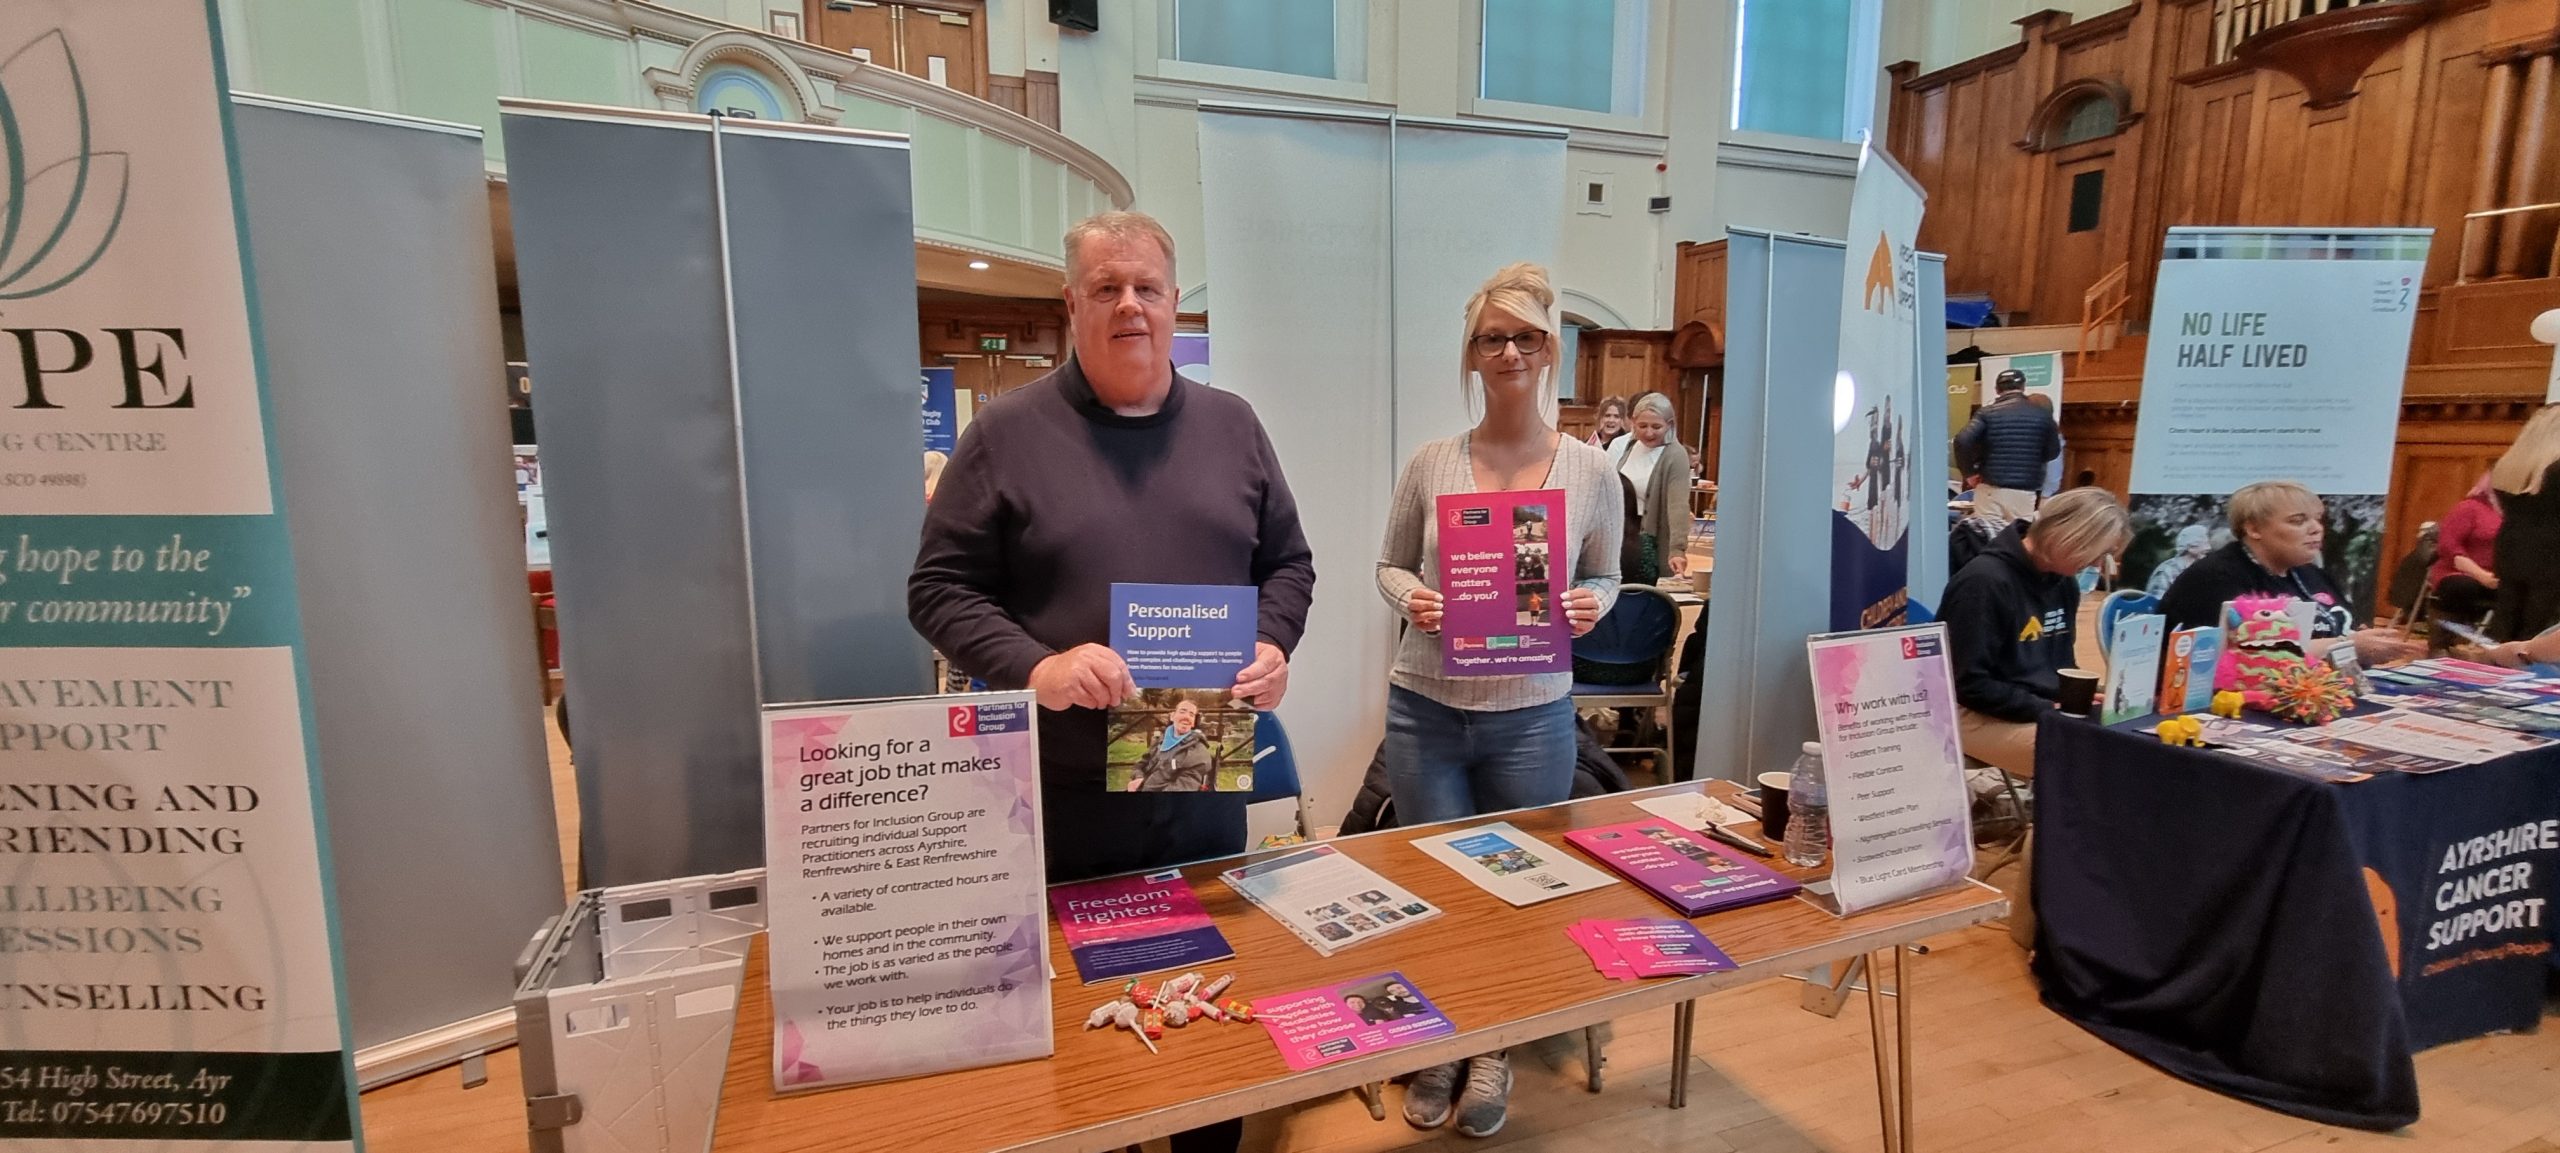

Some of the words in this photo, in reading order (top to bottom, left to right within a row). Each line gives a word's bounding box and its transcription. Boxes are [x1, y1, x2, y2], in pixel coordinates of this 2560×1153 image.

[2181, 312, 2213, 337] NO
[2221, 312, 2267, 337] LIFE
[0, 327, 195, 410] PE
[2177, 343, 2235, 368] HALF
[2242, 343, 2308, 368] LIVED
[34, 432, 166, 452] CENTRE
[17, 534, 101, 585] hope
[111, 546, 145, 572] to
[156, 534, 210, 572] the
[1467, 551, 1504, 561] believe
[1451, 565, 1498, 575] everyone
[1451, 579, 1492, 588] matters
[1474, 591, 1498, 602] you?
[1128, 602, 1228, 619] Personalised
[1127, 623, 1192, 641] Support
[978, 703, 1013, 712] Partners
[1834, 701, 1859, 715] Why
[1860, 697, 1887, 710] work
[1888, 694, 1911, 705] with
[1912, 689, 1928, 703] us?
[978, 712, 1016, 722] Inclusion
[978, 723, 1006, 733] Group
[0, 723, 166, 751] PPORT
[800, 742, 880, 763] Looking
[887, 738, 913, 755] for
[919, 739, 931, 753] a
[800, 767, 854, 791] great
[855, 764, 891, 787] job
[896, 760, 936, 779] that
[941, 755, 1001, 774] makes
[0, 784, 137, 811] NING
[155, 784, 260, 812] AND
[800, 799, 812, 812] a
[818, 784, 929, 810] difference?
[801, 819, 850, 835] Partners
[853, 816, 870, 830] for
[873, 813, 925, 829] Inclusion
[927, 811, 965, 823] Group
[967, 808, 986, 818] are
[0, 826, 244, 854] RIENDING
[801, 832, 860, 850] recruiting
[862, 827, 919, 843] individual
[922, 823, 967, 840] Support
[2438, 819, 2560, 874] AYRSHIRE
[802, 846, 876, 864] Practitioners
[878, 845, 915, 856] across
[917, 839, 968, 853] Ayrshire,
[803, 861, 881, 879] Renfrewshire
[883, 858, 893, 870] &
[896, 855, 921, 868] East
[923, 848, 998, 865] Renfrewshire
[3, 885, 223, 913] LLBEING
[821, 892, 831, 902] A
[833, 885, 874, 901] variety
[876, 884, 889, 895] of
[890, 877, 954, 895] contracted
[956, 873, 989, 886] hours
[991, 871, 1010, 882] are
[1068, 888, 1171, 911] Freedom
[2435, 861, 2533, 912] CANCER
[821, 902, 877, 917] available.
[1073, 902, 1172, 925] Fighters
[822, 934, 844, 946] We
[846, 929, 892, 945] support
[895, 924, 936, 939] people
[938, 920, 949, 931] in
[952, 917, 978, 930] their
[980, 915, 1007, 926] own
[2426, 898, 2546, 950] SUPPORT
[0, 927, 203, 954] ESSIONS
[822, 948, 864, 961] homes
[866, 943, 890, 956] and
[893, 940, 904, 952] in
[906, 938, 926, 951] the
[929, 931, 996, 947] community.
[823, 965, 846, 977] The
[847, 961, 869, 977] job
[871, 959, 881, 970] is
[883, 958, 896, 968] as
[898, 952, 934, 966] varied
[937, 951, 950, 961] as
[952, 946, 972, 958] the
[975, 941, 1013, 957] people
[824, 979, 843, 990] we
[846, 974, 877, 987] work
[879, 969, 909, 982] with.
[0, 984, 266, 1011] NSELLING
[827, 1003, 855, 1016] Your
[855, 999, 877, 1015] job
[879, 997, 889, 1009] is
[891, 995, 904, 1007] to
[906, 991, 932, 1007] help
[935, 983, 995, 1001] individuals
[997, 980, 1014, 992] do
[1265, 996, 1326, 1014] supporting
[827, 1018, 847, 1030] the
[850, 1012, 887, 1029] things
[890, 1008, 916, 1022] they
[918, 1004, 943, 1018] love
[945, 1002, 958, 1013] to
[960, 1000, 978, 1012] do.
[1296, 1023, 1317, 1032] live
[1317, 1016, 1342, 1027] how
[1289, 1032, 1316, 1044] they
[1317, 1022, 1356, 1036] choose
[0, 1067, 31, 1089] 54
[38, 1065, 98, 1097] High
[106, 1066, 180, 1091] Street,
[188, 1068, 232, 1096] Ayr
[2, 1099, 46, 1122] Tel:
[52, 1101, 226, 1125] 07547697510
